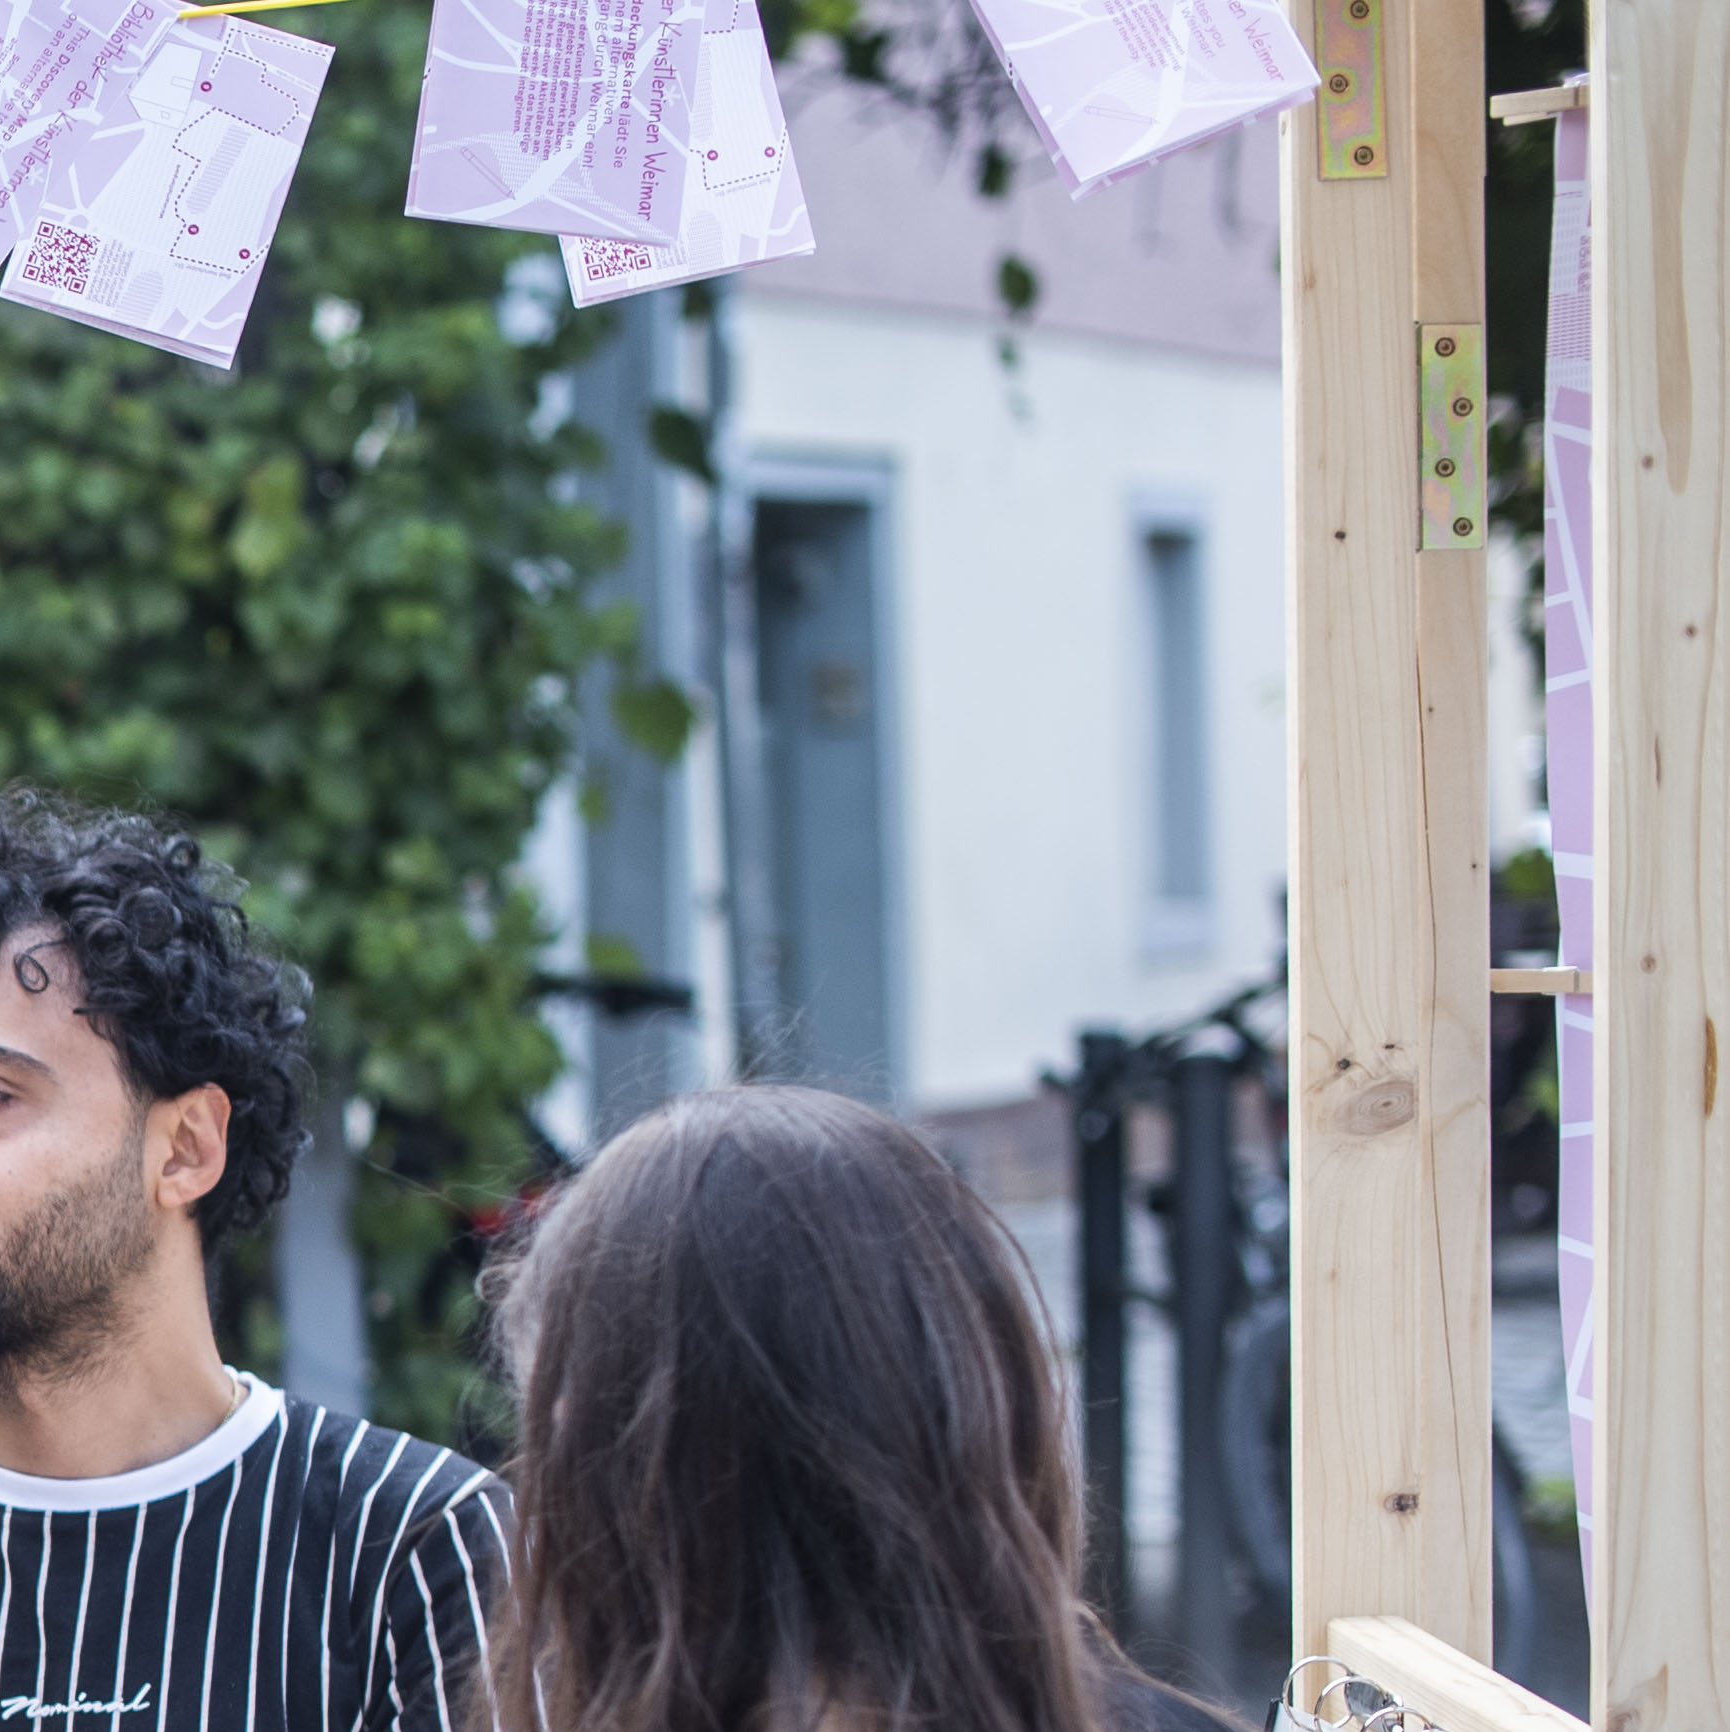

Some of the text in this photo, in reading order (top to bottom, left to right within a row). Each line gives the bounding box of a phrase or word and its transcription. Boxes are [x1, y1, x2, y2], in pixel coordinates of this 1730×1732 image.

[62, 13, 78, 30] on
[523, 26, 532, 42] der
[578, 24, 587, 40] der
[49, 30, 65, 47] an
[65, 27, 91, 53] This
[91, 0, 155, 83] Bibliothek
[565, 22, 576, 55] gelebt
[1204, 25, 1226, 49] you
[1243, 17, 1285, 81] Weimar
[519, 46, 530, 73] Stadt
[541, 32, 553, 78] kreativer
[549, 21, 566, 103] Reiseleiterinnen
[562, 57, 571, 77] und
[4, 47, 53, 112] alternative
[21, 53, 71, 114] Discovery
[67, 80, 94, 109] der
[519, 18, 544, 153] Kunstwerke in das heutige
[603, 37, 623, 125] alternativen
[645, 21, 682, 144] Künstlerinnen
[534, 80, 548, 137] Aktivitäten
[558, 81, 569, 119] gewirkt
[581, 34, 608, 168] durch Weimar ein!
[2, 114, 28, 142] Map
[546, 106, 555, 126] und
[566, 121, 576, 136] die
[616, 113, 631, 142] lädt
[542, 129, 553, 161] bieten
[565, 139, 573, 149] in
[613, 146, 627, 168] Sie
[637, 151, 668, 222] Weimar
